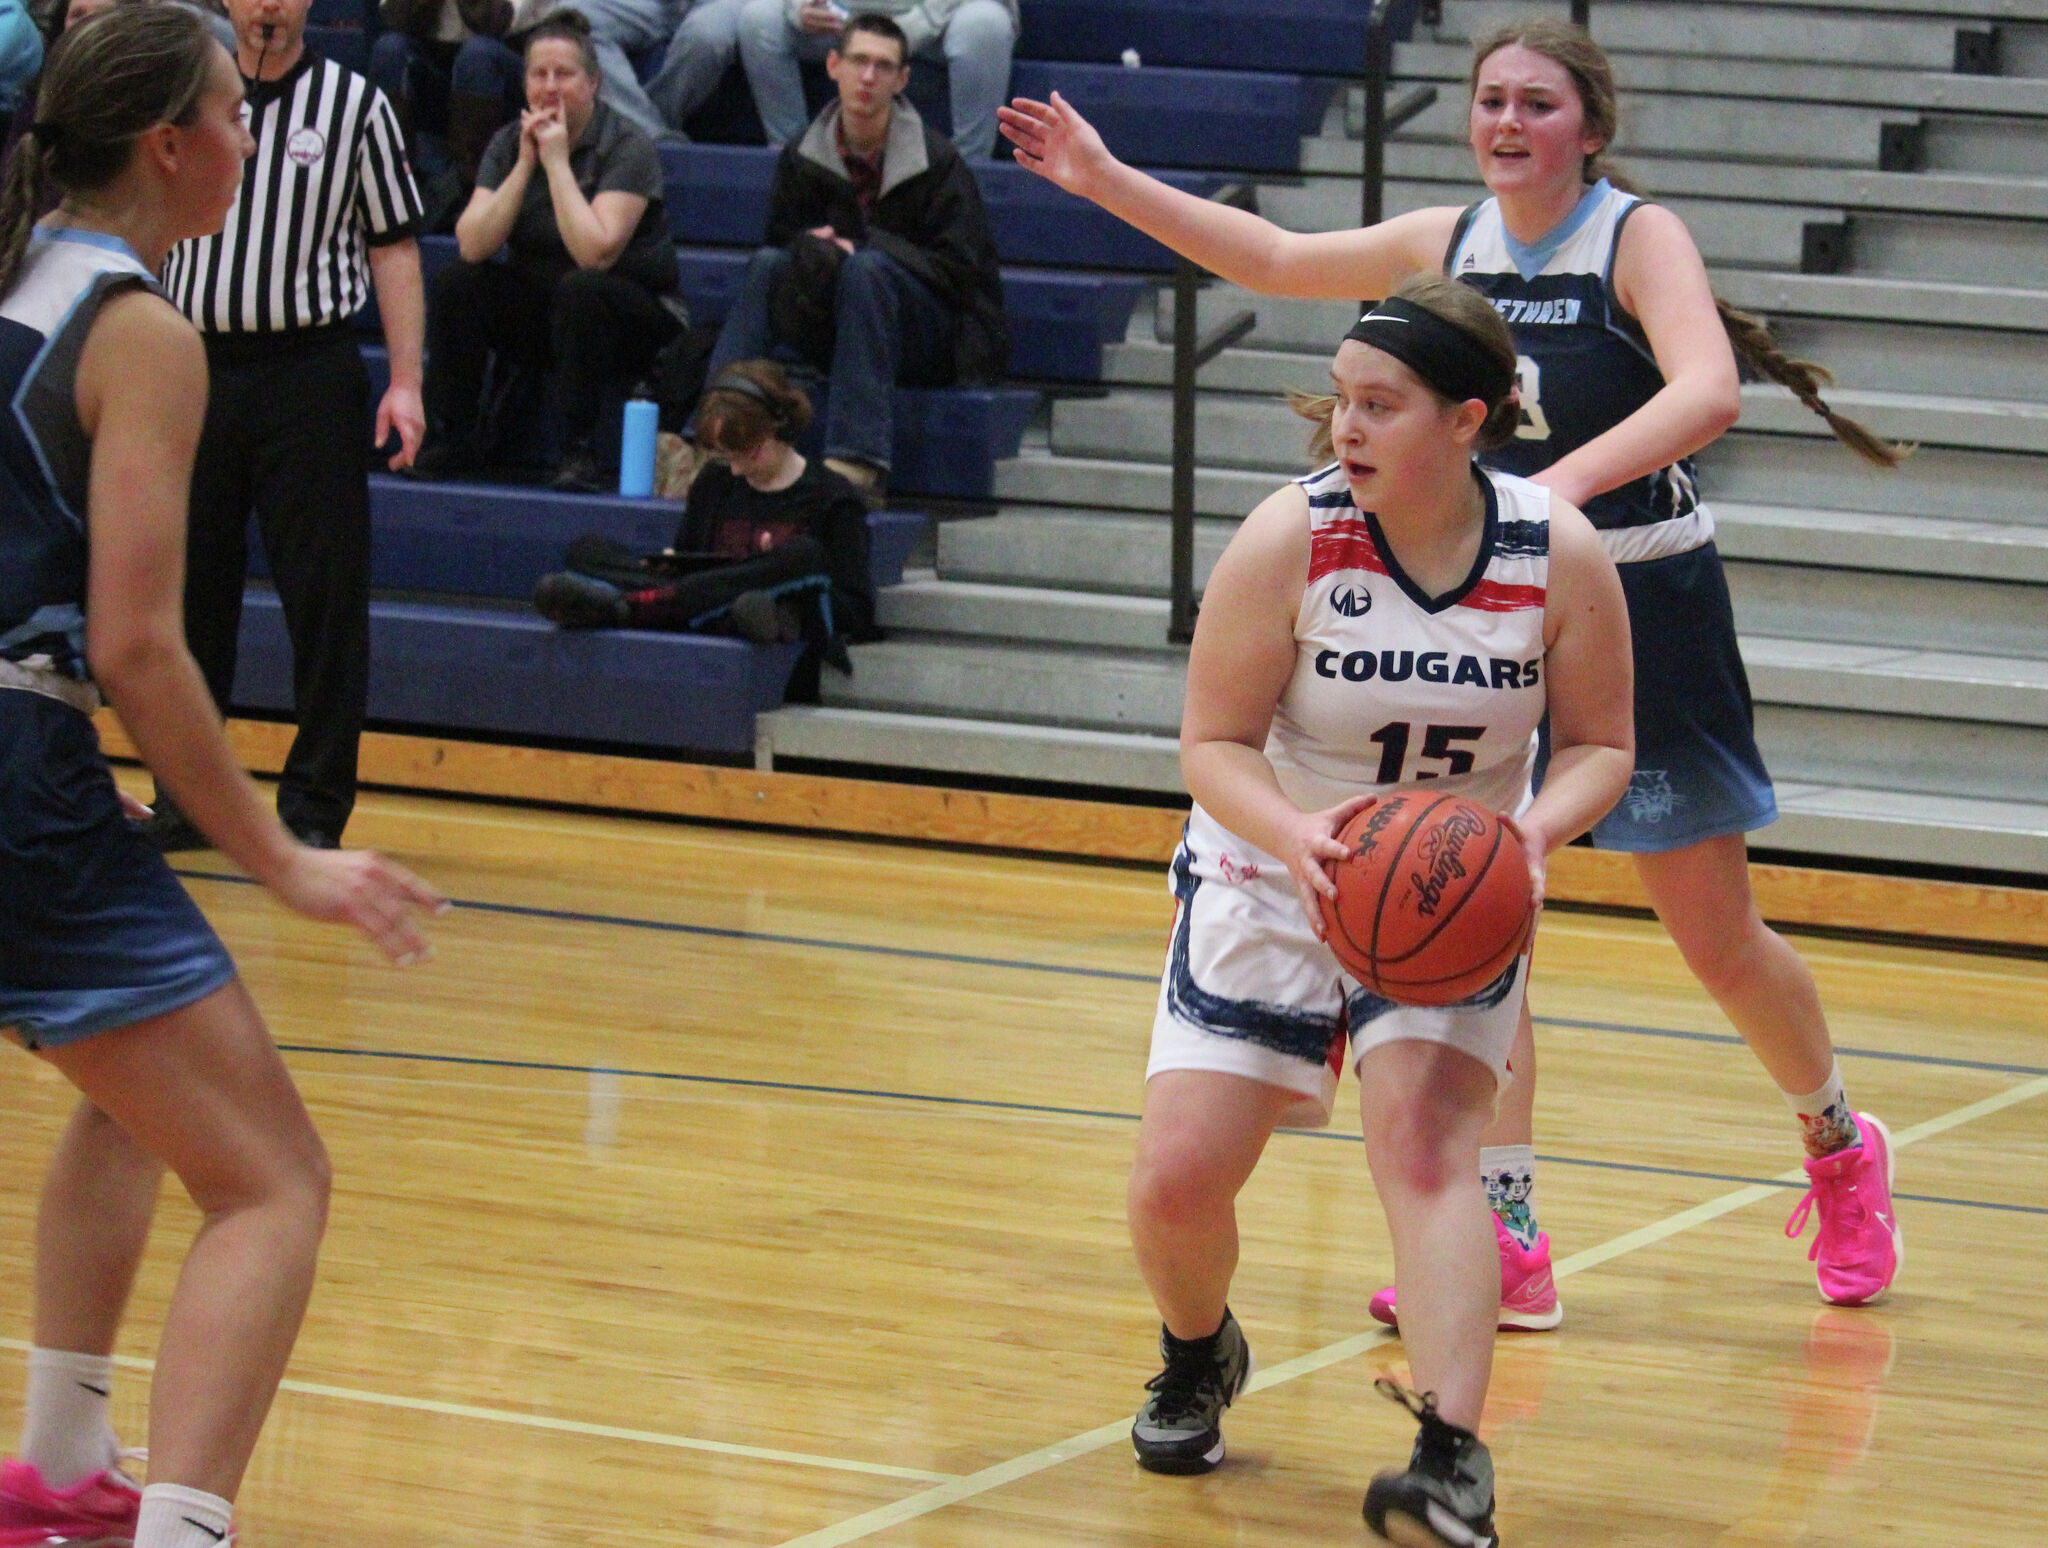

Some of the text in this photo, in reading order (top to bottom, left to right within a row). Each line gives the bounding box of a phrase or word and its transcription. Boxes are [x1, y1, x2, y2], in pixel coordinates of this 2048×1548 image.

[1486, 298, 1582, 325] ETHREN
[1315, 649, 1540, 689] COUGARS
[1370, 721, 1488, 784] 15
[1411, 805, 1487, 917] Rawlings
